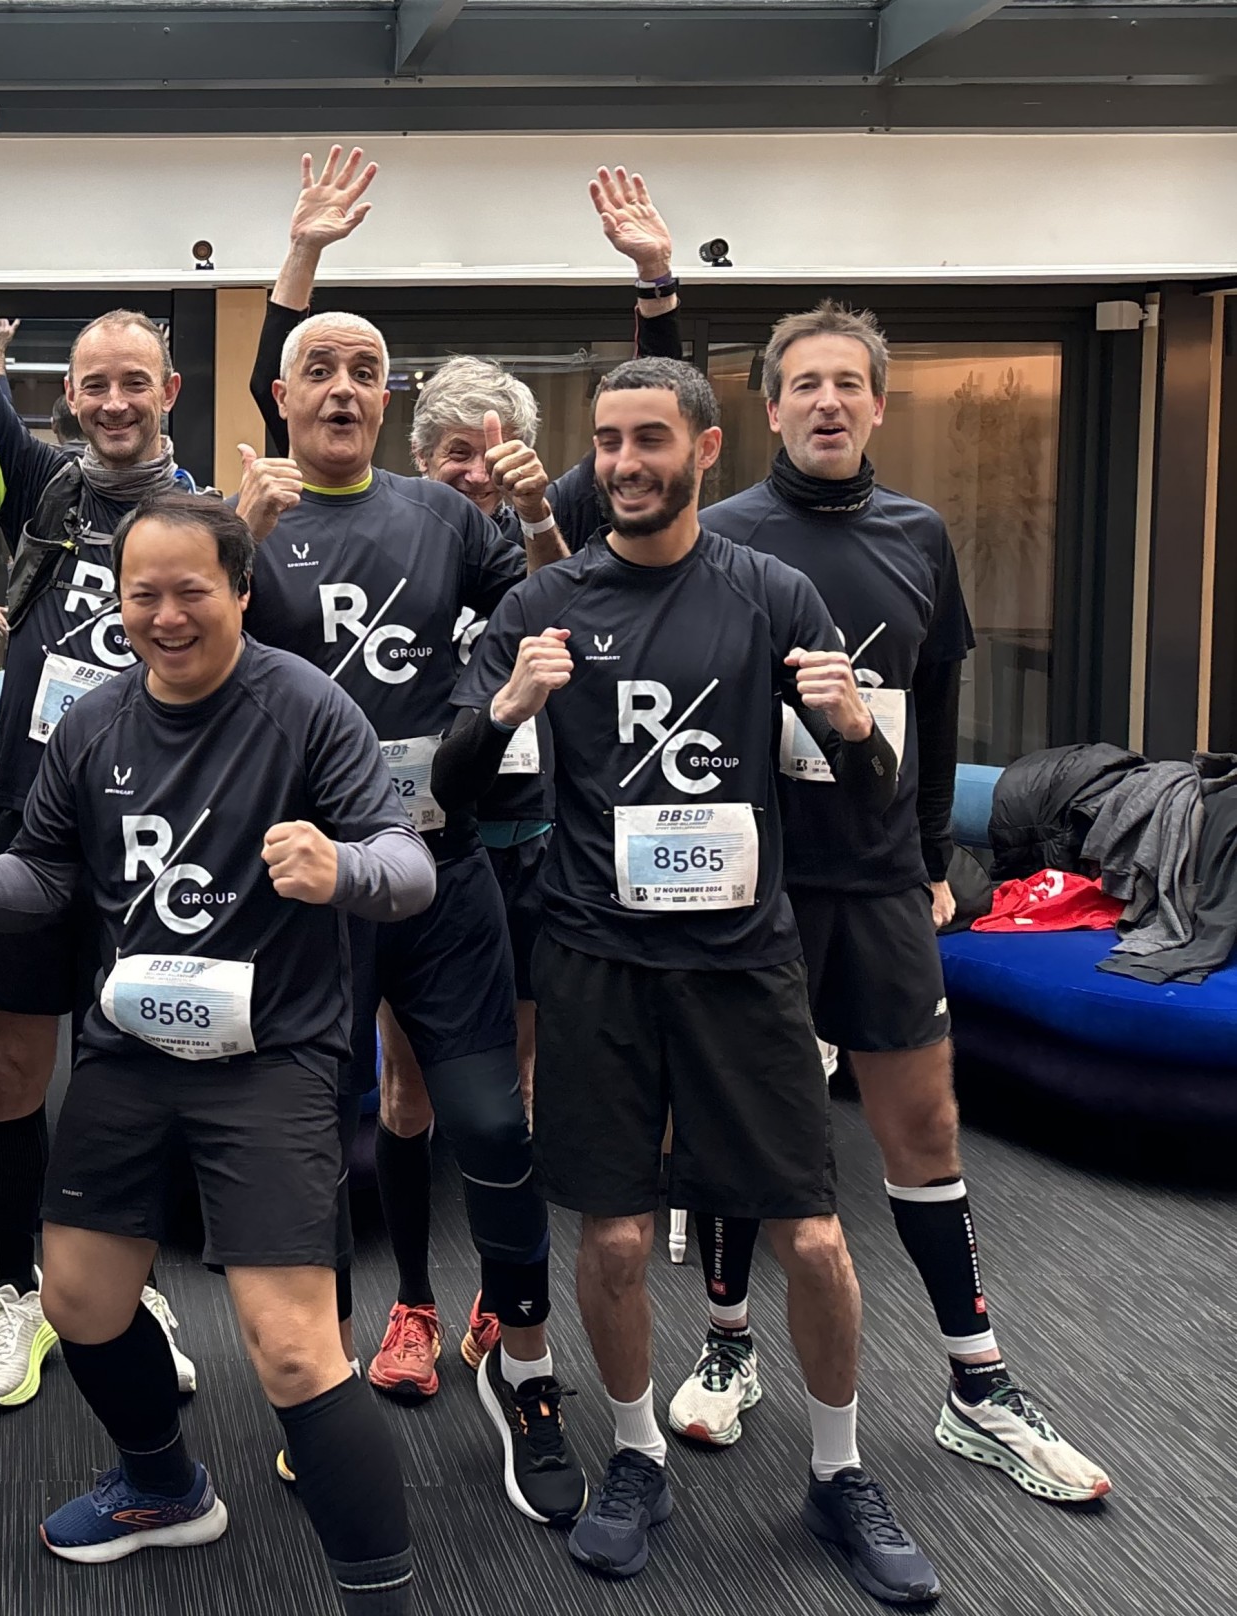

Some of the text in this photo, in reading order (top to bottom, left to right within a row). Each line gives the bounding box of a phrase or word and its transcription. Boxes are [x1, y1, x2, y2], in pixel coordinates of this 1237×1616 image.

[389, 647, 433, 659] GROUP
[689, 756, 740, 769] GROUP
[658, 809, 706, 822] BBSD
[653, 846, 724, 873] 8565
[180, 892, 237, 905] GROUP
[149, 960, 196, 974] BBSD
[140, 997, 211, 1028] 8563
